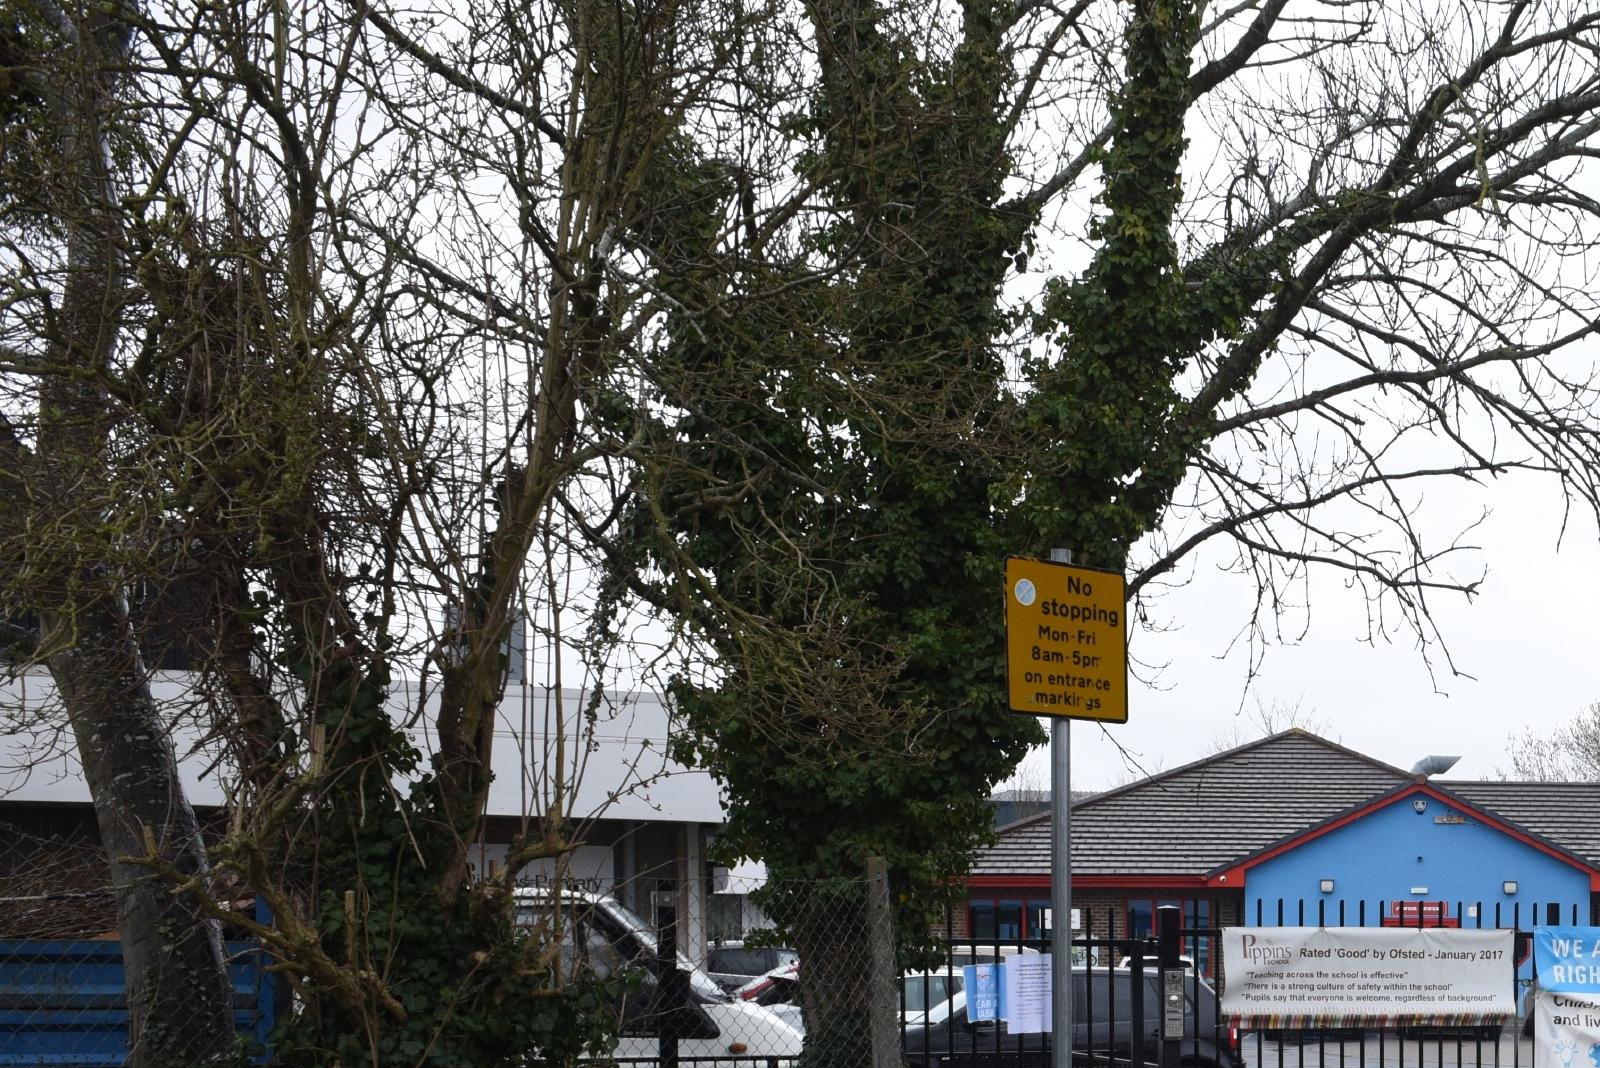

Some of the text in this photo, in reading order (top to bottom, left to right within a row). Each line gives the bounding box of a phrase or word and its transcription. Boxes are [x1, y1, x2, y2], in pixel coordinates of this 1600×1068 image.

[1067, 576, 1092, 596] No
[1041, 599, 1118, 627] stopping
[1025, 671, 1042, 684] on
[1242, 934, 1292, 965] Pippins
[1299, 948, 1331, 958] Rated
[1334, 948, 1370, 959] 'Good'
[1373, 949, 1386, 960] by
[1389, 949, 1425, 959] Ofsted
[1434, 950, 1477, 961] January
[1480, 950, 1504, 960] 2017
[1552, 939, 1583, 958] WE
[1316, 971, 1329, 979] the
[1331, 971, 1359, 979] school
[1361, 971, 1368, 979] is
[1288, 983, 1315, 992] strong
[1357, 983, 1381, 992] safety
[1383, 983, 1407, 991] within
[1409, 983, 1422, 991] the
[1307, 994, 1344, 1002] everyone
[1394, 994, 1436, 1003] regardless
[1553, 1014, 1581, 1026] and
